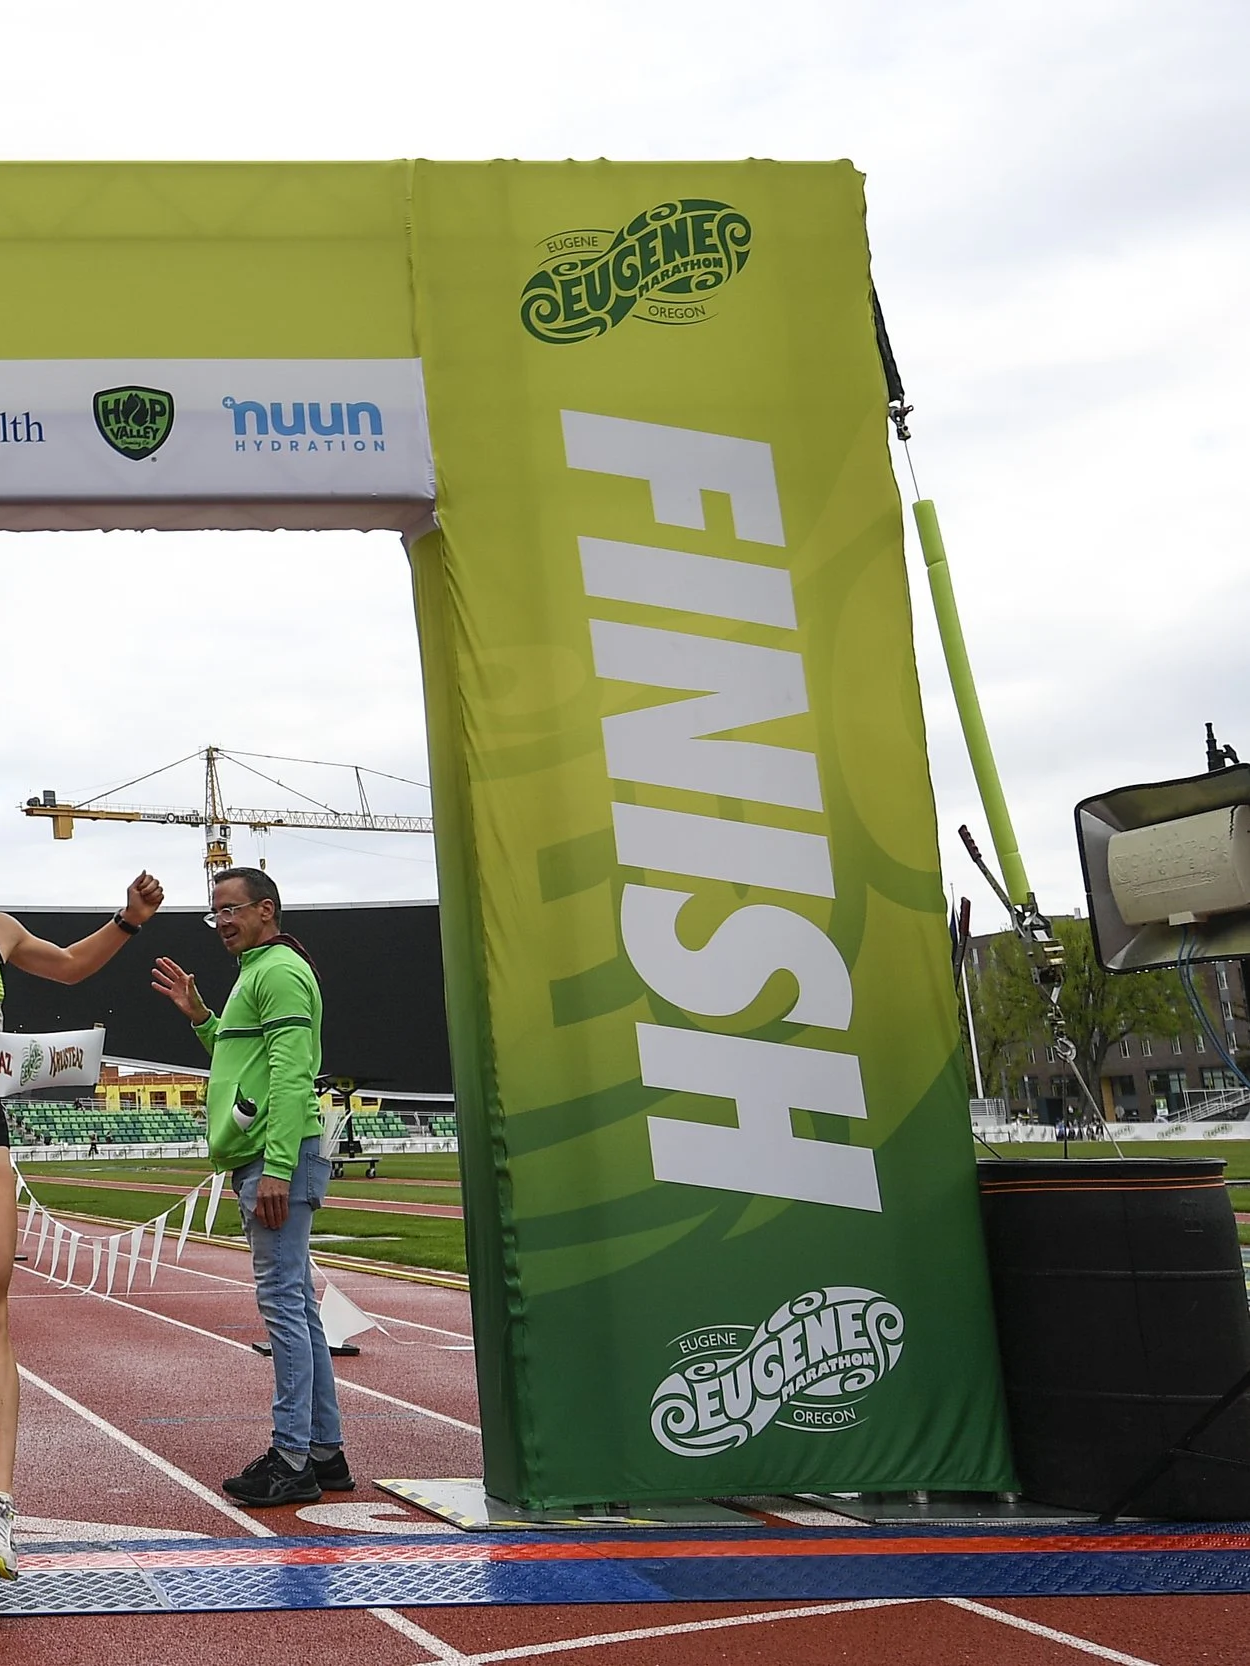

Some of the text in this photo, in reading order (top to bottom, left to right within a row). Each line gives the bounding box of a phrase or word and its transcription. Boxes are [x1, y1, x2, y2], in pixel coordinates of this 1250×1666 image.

[546, 236, 598, 253] EUGENE
[550, 208, 730, 326] EUGENE
[639, 257, 724, 298] MARATHON
[648, 304, 706, 318] OREGON
[102, 392, 167, 427] HOP
[232, 401, 384, 436] nuun
[109, 426, 160, 441] VALLEY
[235, 440, 386, 452] HYDRATION
[560, 408, 882, 1214] FINISH
[678, 1332, 738, 1354] EUGENE
[683, 1297, 881, 1437] EUGENE
[781, 1352, 875, 1403] MARATHON
[793, 1407, 857, 1425] OREGON
